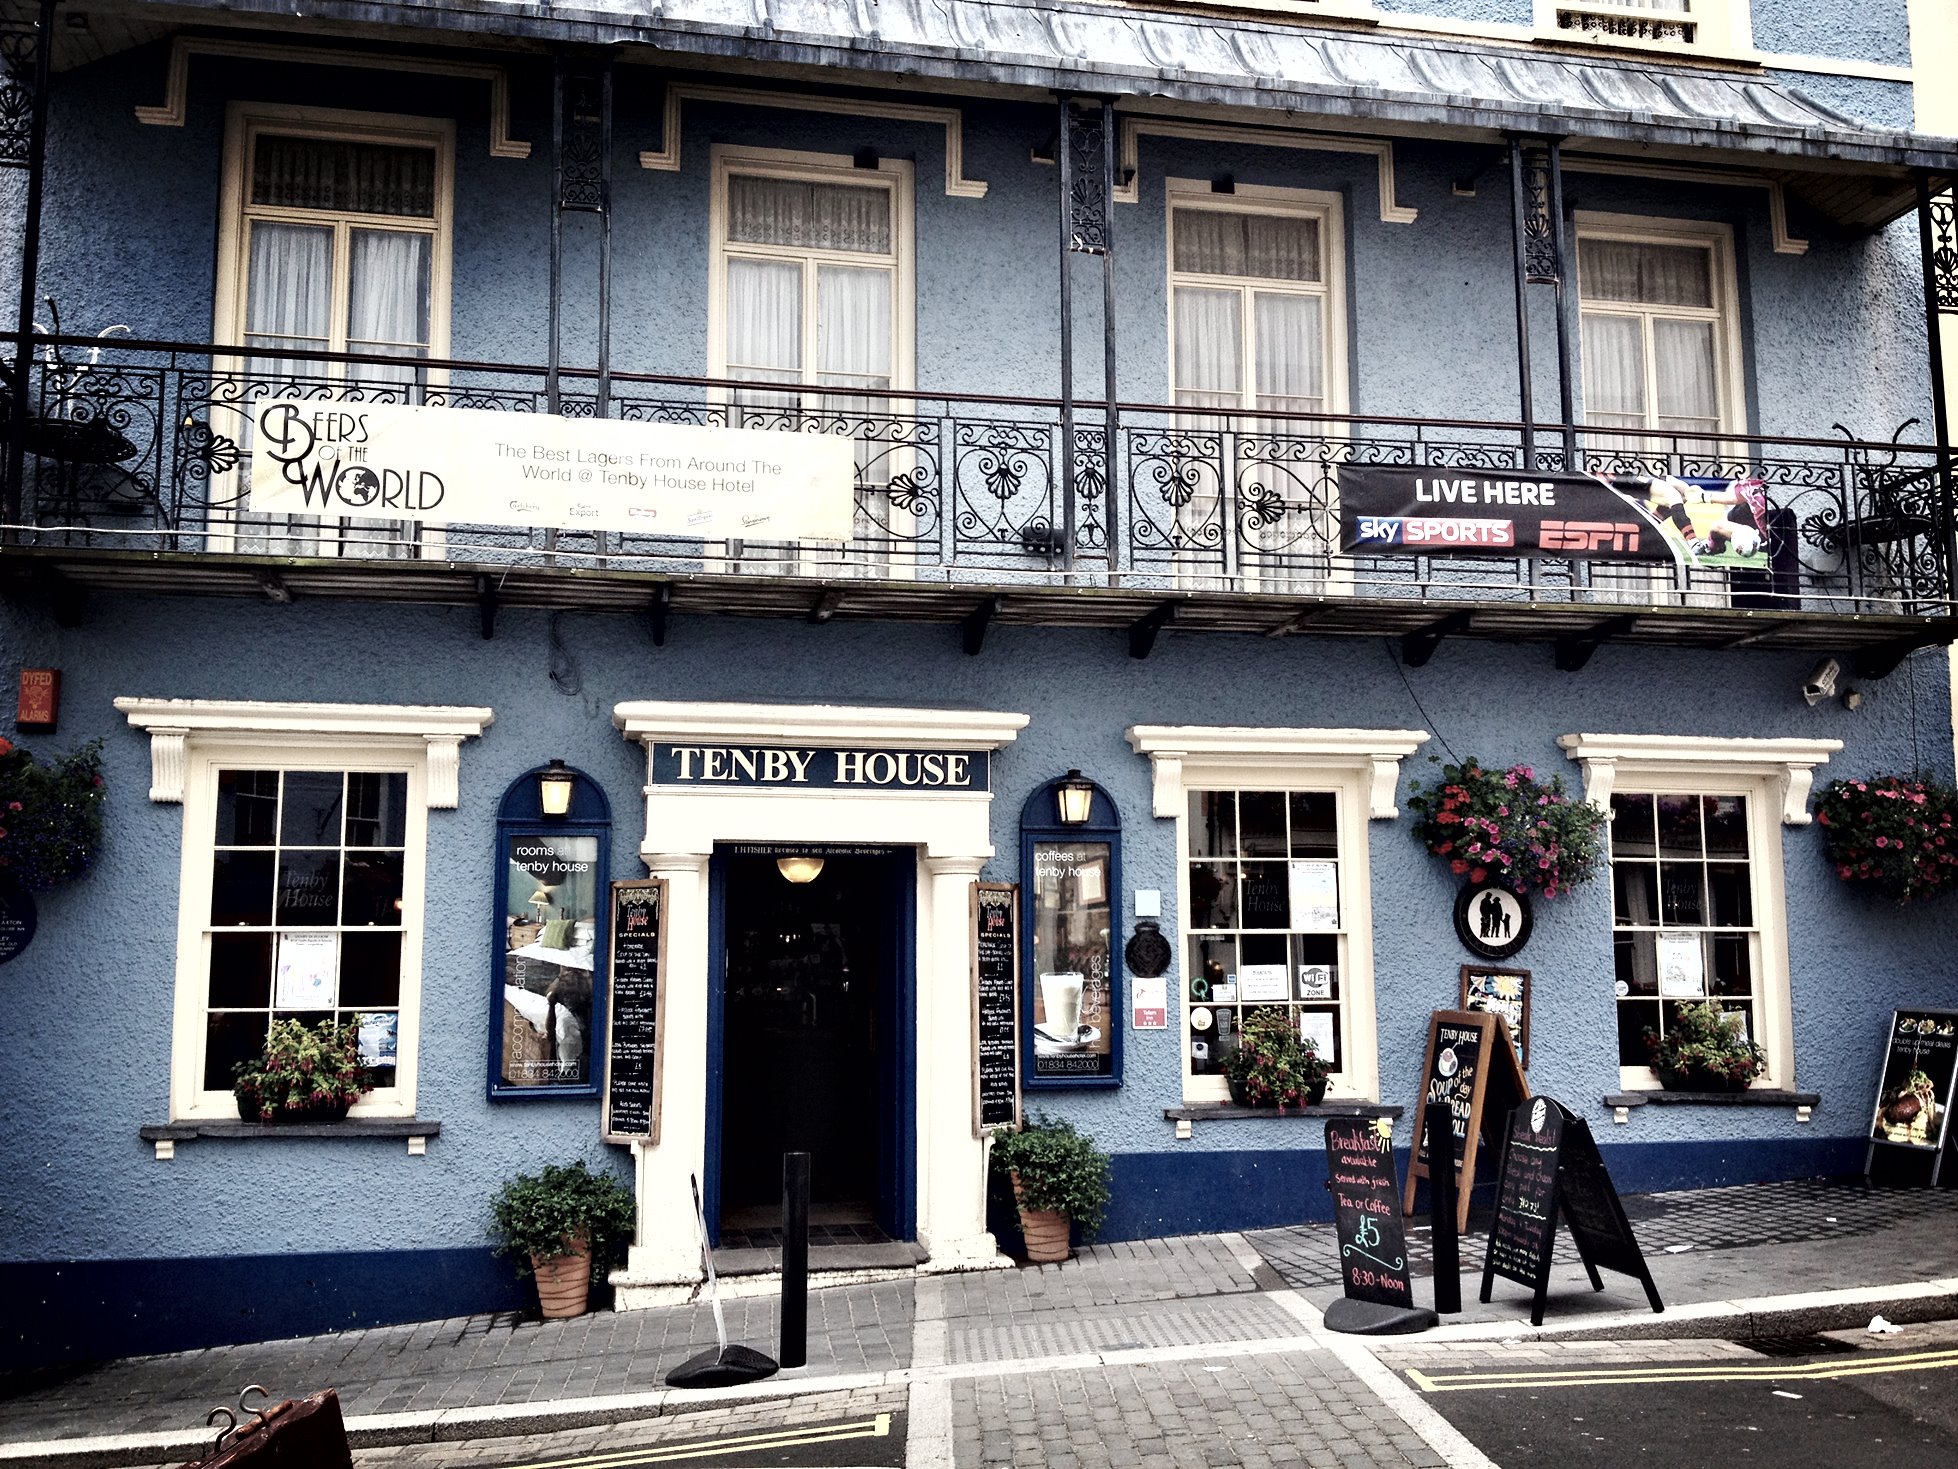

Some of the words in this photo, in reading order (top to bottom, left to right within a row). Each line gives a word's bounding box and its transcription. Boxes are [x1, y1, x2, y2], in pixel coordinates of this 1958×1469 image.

[260, 403, 369, 460] BEERS
[318, 445, 341, 461] OF
[347, 446, 369, 463] THE
[495, 442, 527, 459] The
[533, 445, 571, 462] Best
[577, 448, 634, 467] Lagers
[640, 452, 681, 470] From
[687, 456, 747, 474] Around
[752, 459, 782, 476] The
[282, 459, 445, 509] WORLD
[522, 464, 571, 483] World
[578, 469, 593, 484] @
[600, 469, 648, 490] Tenby
[654, 474, 707, 492] House
[712, 478, 755, 494] Hotel
[1415, 478, 1478, 504] LIVE
[1485, 481, 1556, 506] HERE
[1360, 519, 1400, 544] sky
[1406, 518, 1511, 545] SPORTS
[1539, 520, 1641, 552] ESPN
[22, 671, 52, 686] DYFED
[19, 710, 49, 722] ALARMS
[671, 747, 816, 782] TENBY
[833, 751, 971, 786] HOUSE
[516, 846, 555, 856] rooms
[1035, 850, 1074, 861] coffees
[1076, 851, 1086, 861] at
[516, 861, 549, 874] tenby
[552, 861, 588, 872] house
[1035, 866, 1066, 879] tenby
[284, 869, 329, 892] Tenby
[1245, 878, 1281, 897] Tenby
[284, 888, 334, 908] House
[1248, 896, 1285, 912] House
[1091, 955, 1104, 1023] beverages
[1440, 1028, 1458, 1043] TENBY
[1458, 1030, 1478, 1045] HOUSE
[509, 1068, 540, 1079] 01834
[542, 1067, 579, 1079] 842000
[1037, 1060, 1065, 1069] 01834
[1066, 1059, 1099, 1069] 842000
[1462, 1065, 1473, 1079] the
[1452, 1119, 1466, 1139] OLL
[1330, 1128, 1381, 1152] Breakfast
[1341, 1154, 1377, 1168] available
[1338, 1192, 1354, 1207] Tea
[1355, 1200, 1363, 1209] or
[1365, 1198, 1391, 1216] Coffee
[1355, 1214, 1380, 1248] £5
